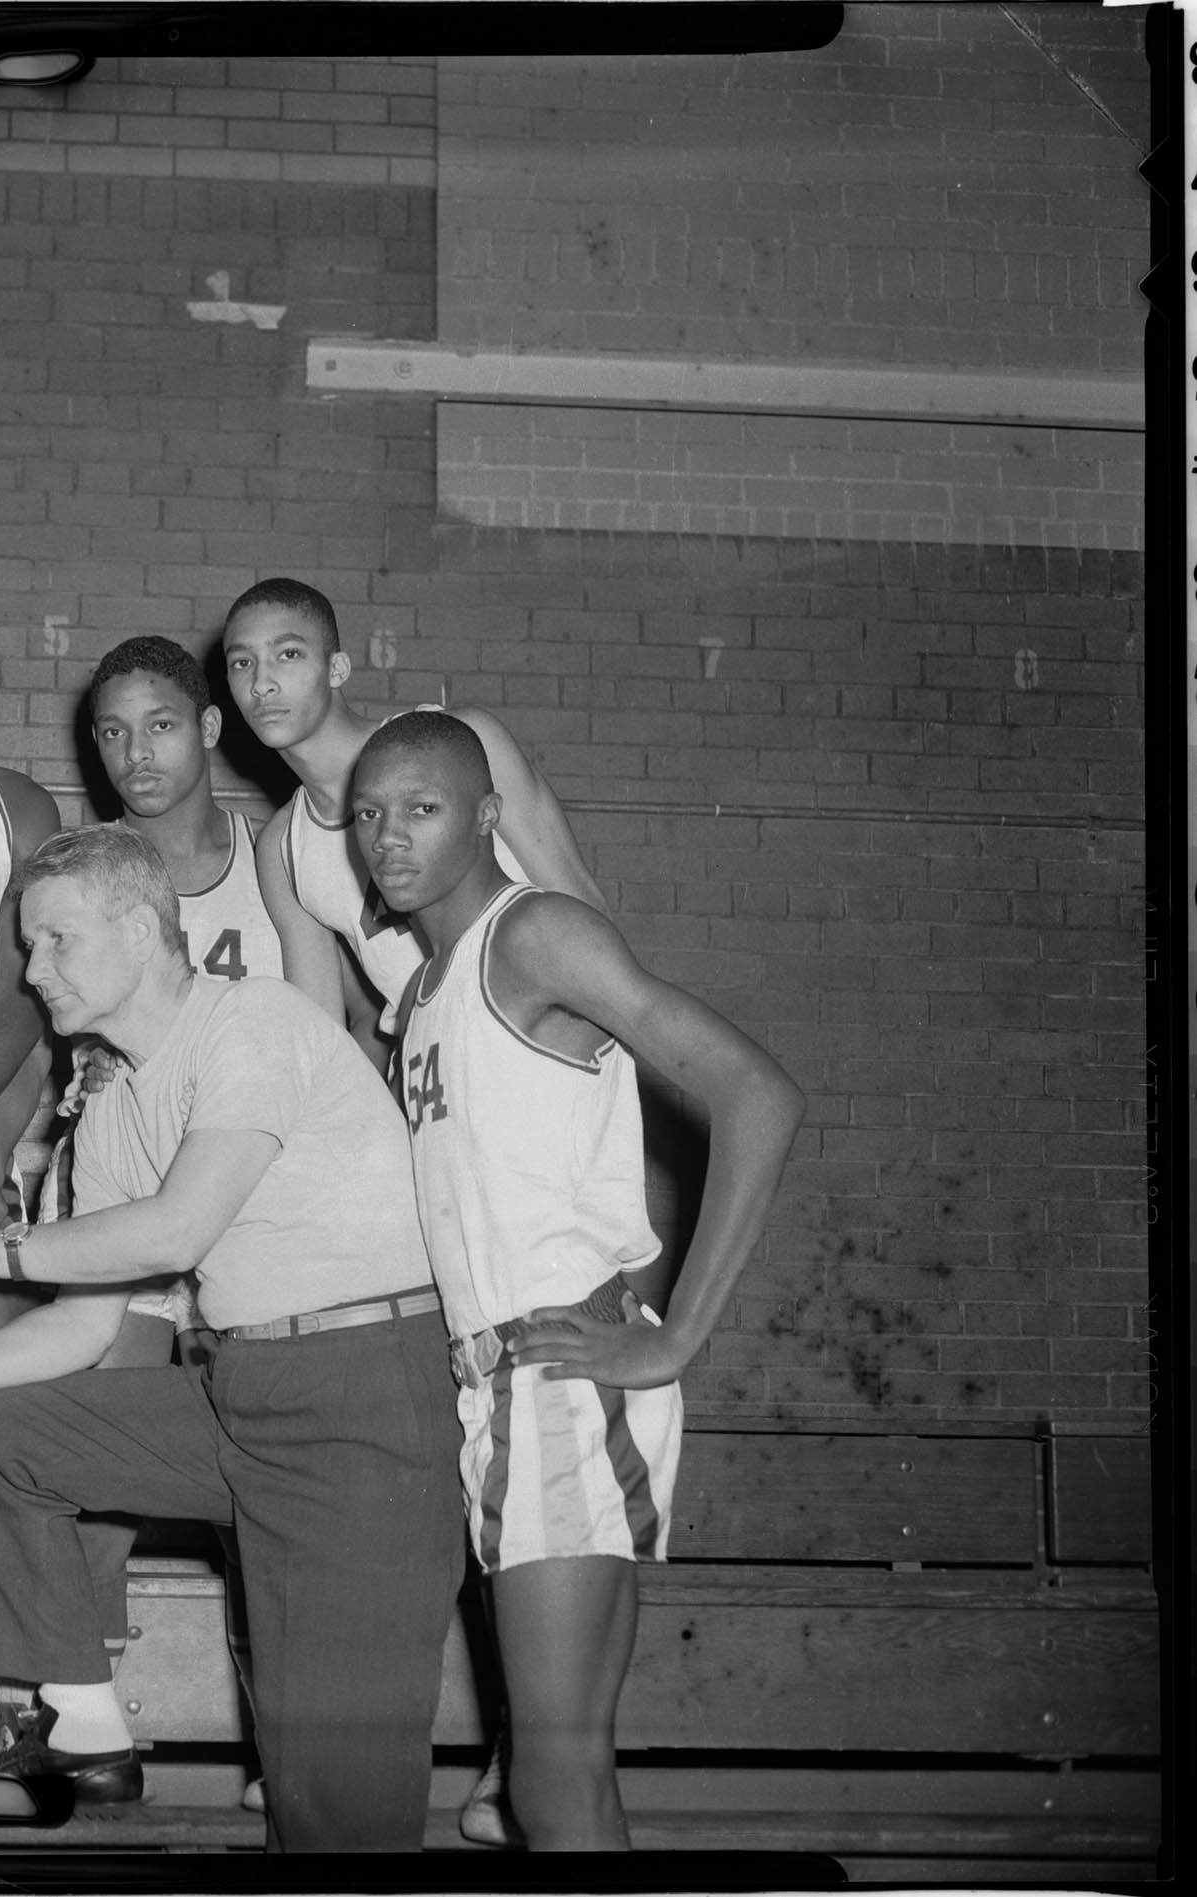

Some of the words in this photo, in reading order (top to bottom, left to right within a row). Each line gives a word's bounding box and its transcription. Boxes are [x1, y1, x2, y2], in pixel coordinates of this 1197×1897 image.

[43, 615, 70, 656] 5
[370, 629, 397, 669] 6
[699, 637, 725, 679] 7
[1014, 649, 1039, 689] 8
